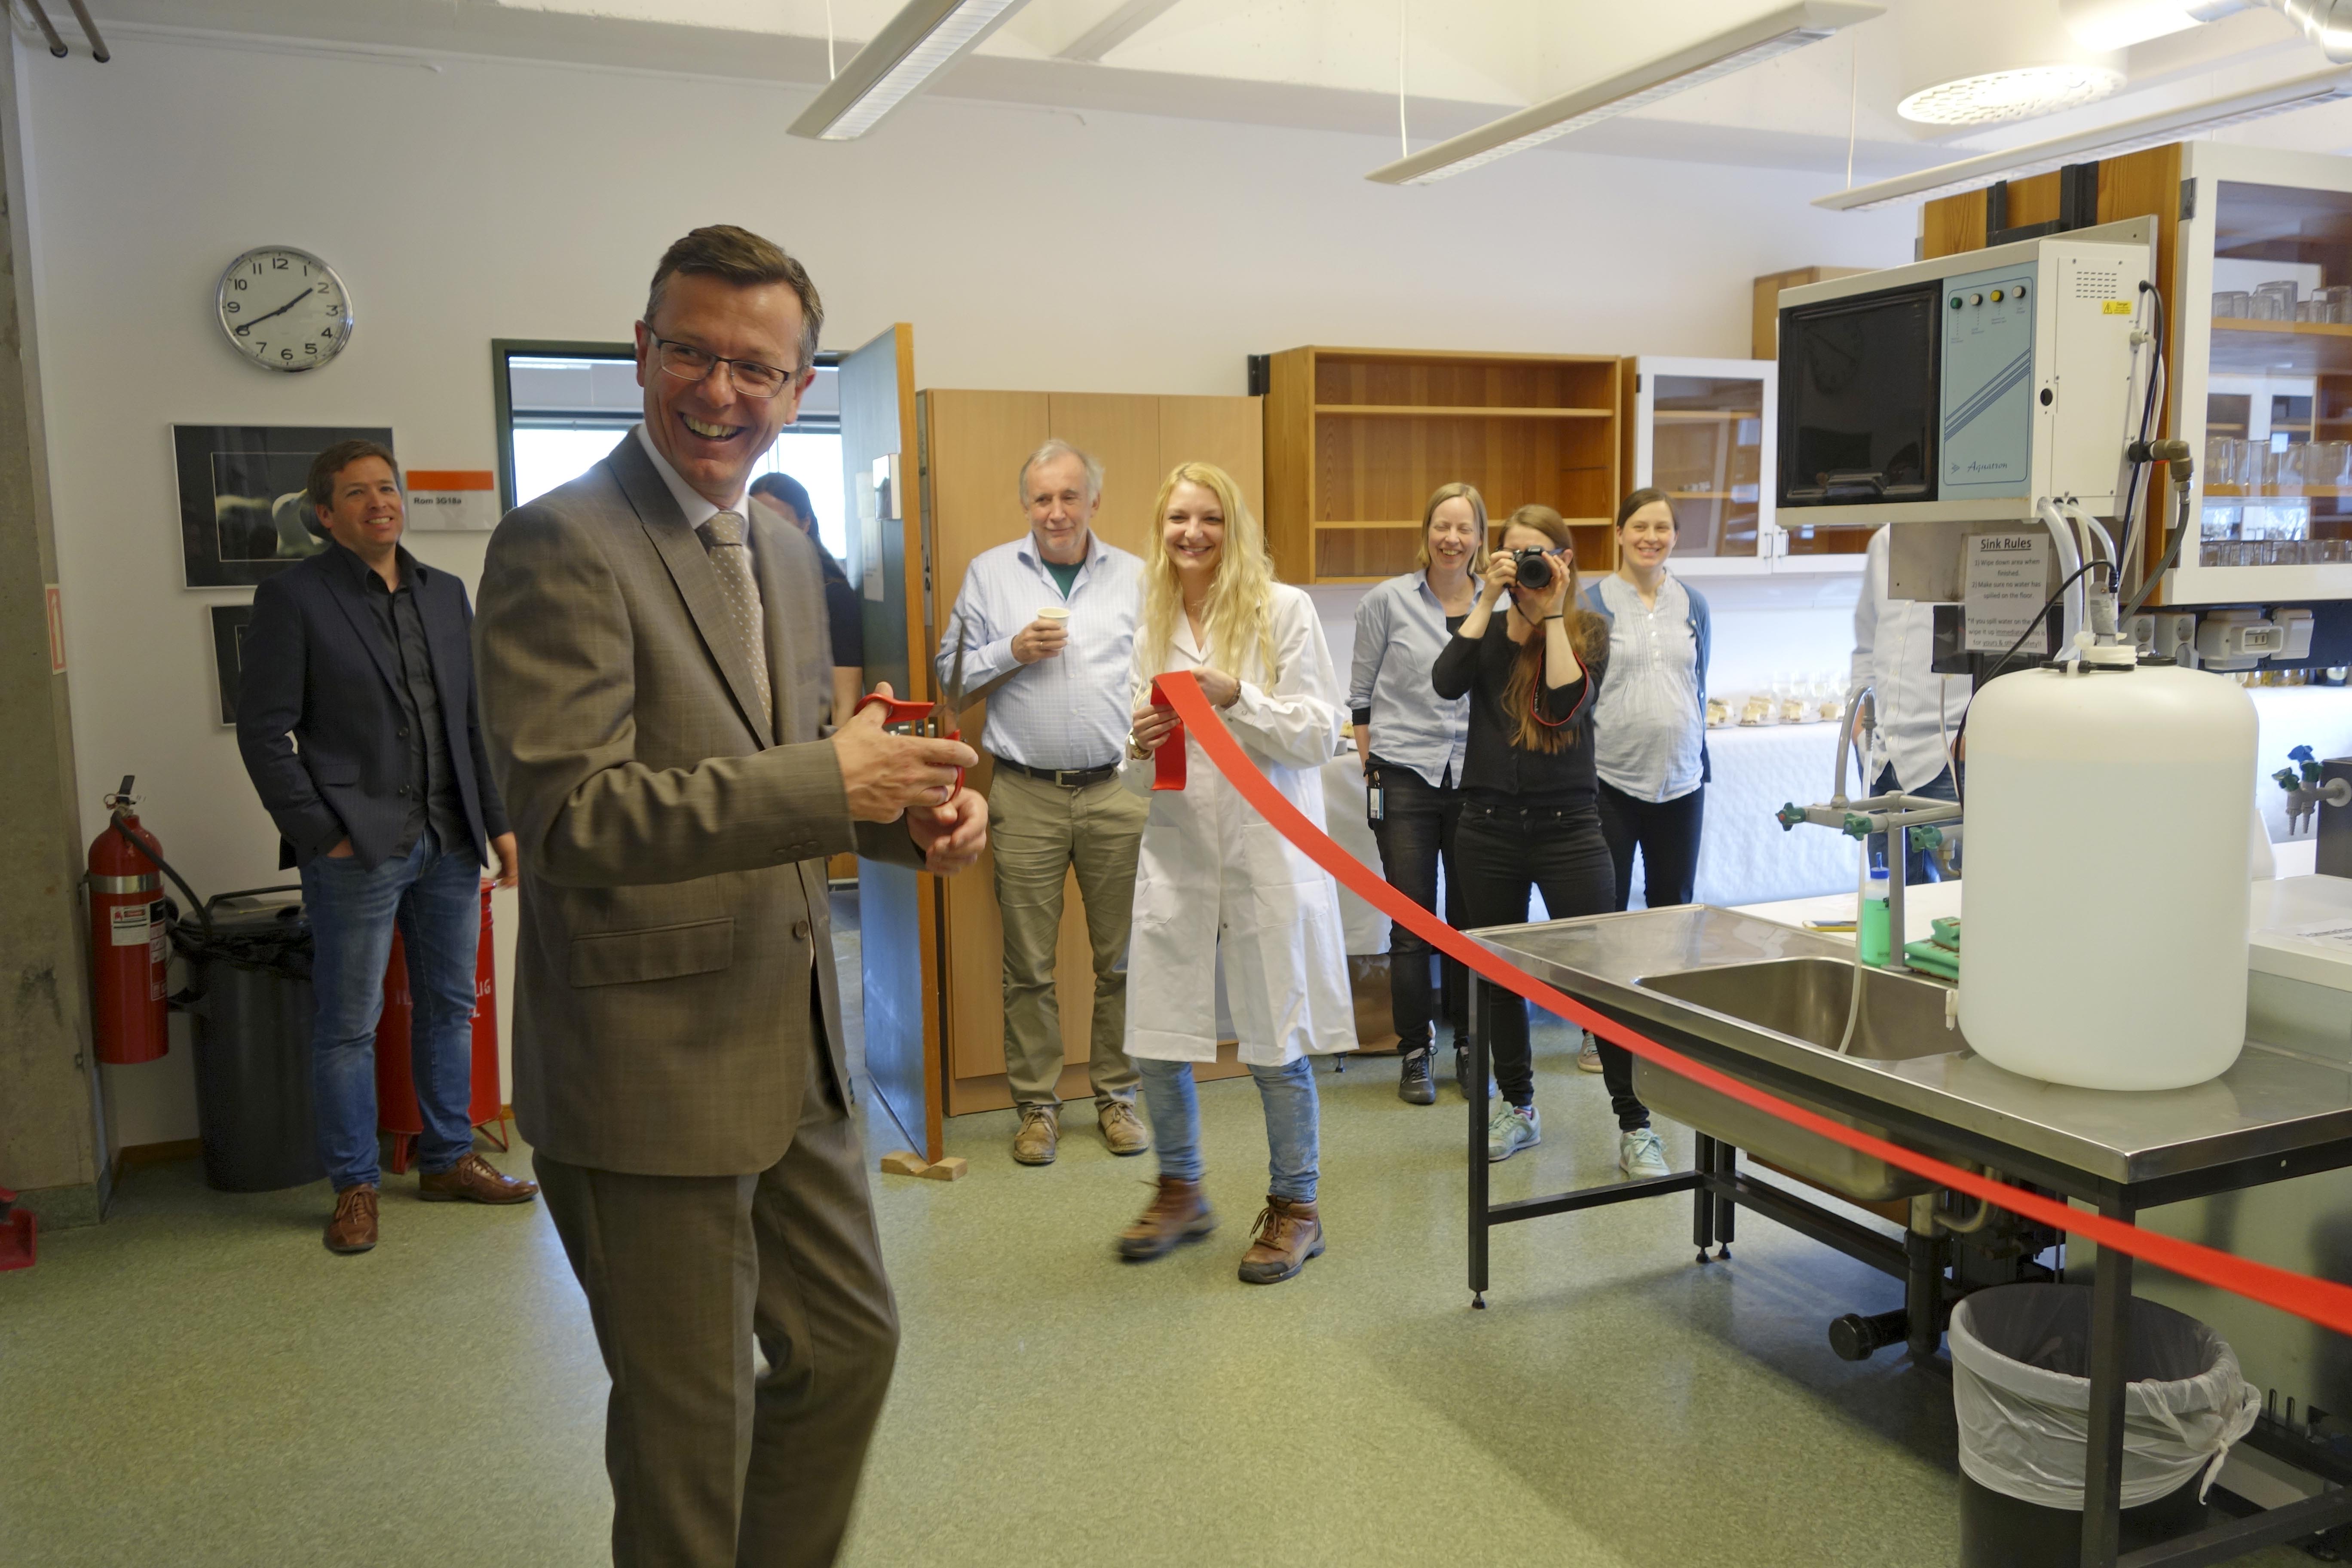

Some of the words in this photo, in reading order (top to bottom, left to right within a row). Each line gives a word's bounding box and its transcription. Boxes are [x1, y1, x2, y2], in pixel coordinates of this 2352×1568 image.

[252, 263, 262, 275] 11
[273, 258, 288, 270] 12
[303, 265, 307, 276] 1
[234, 279, 248, 290] 10
[317, 282, 329, 294] 2
[227, 301, 240, 313] 9
[326, 305, 338, 316] 3
[321, 327, 333, 338] 4
[256, 342, 267, 354] 7
[305, 343, 317, 354] 5
[281, 349, 293, 360] 6
[1967, 461, 2007, 473] Aquatron
[1981, 538, 2001, 550] Sink
[2004, 538, 2031, 549] Rules
